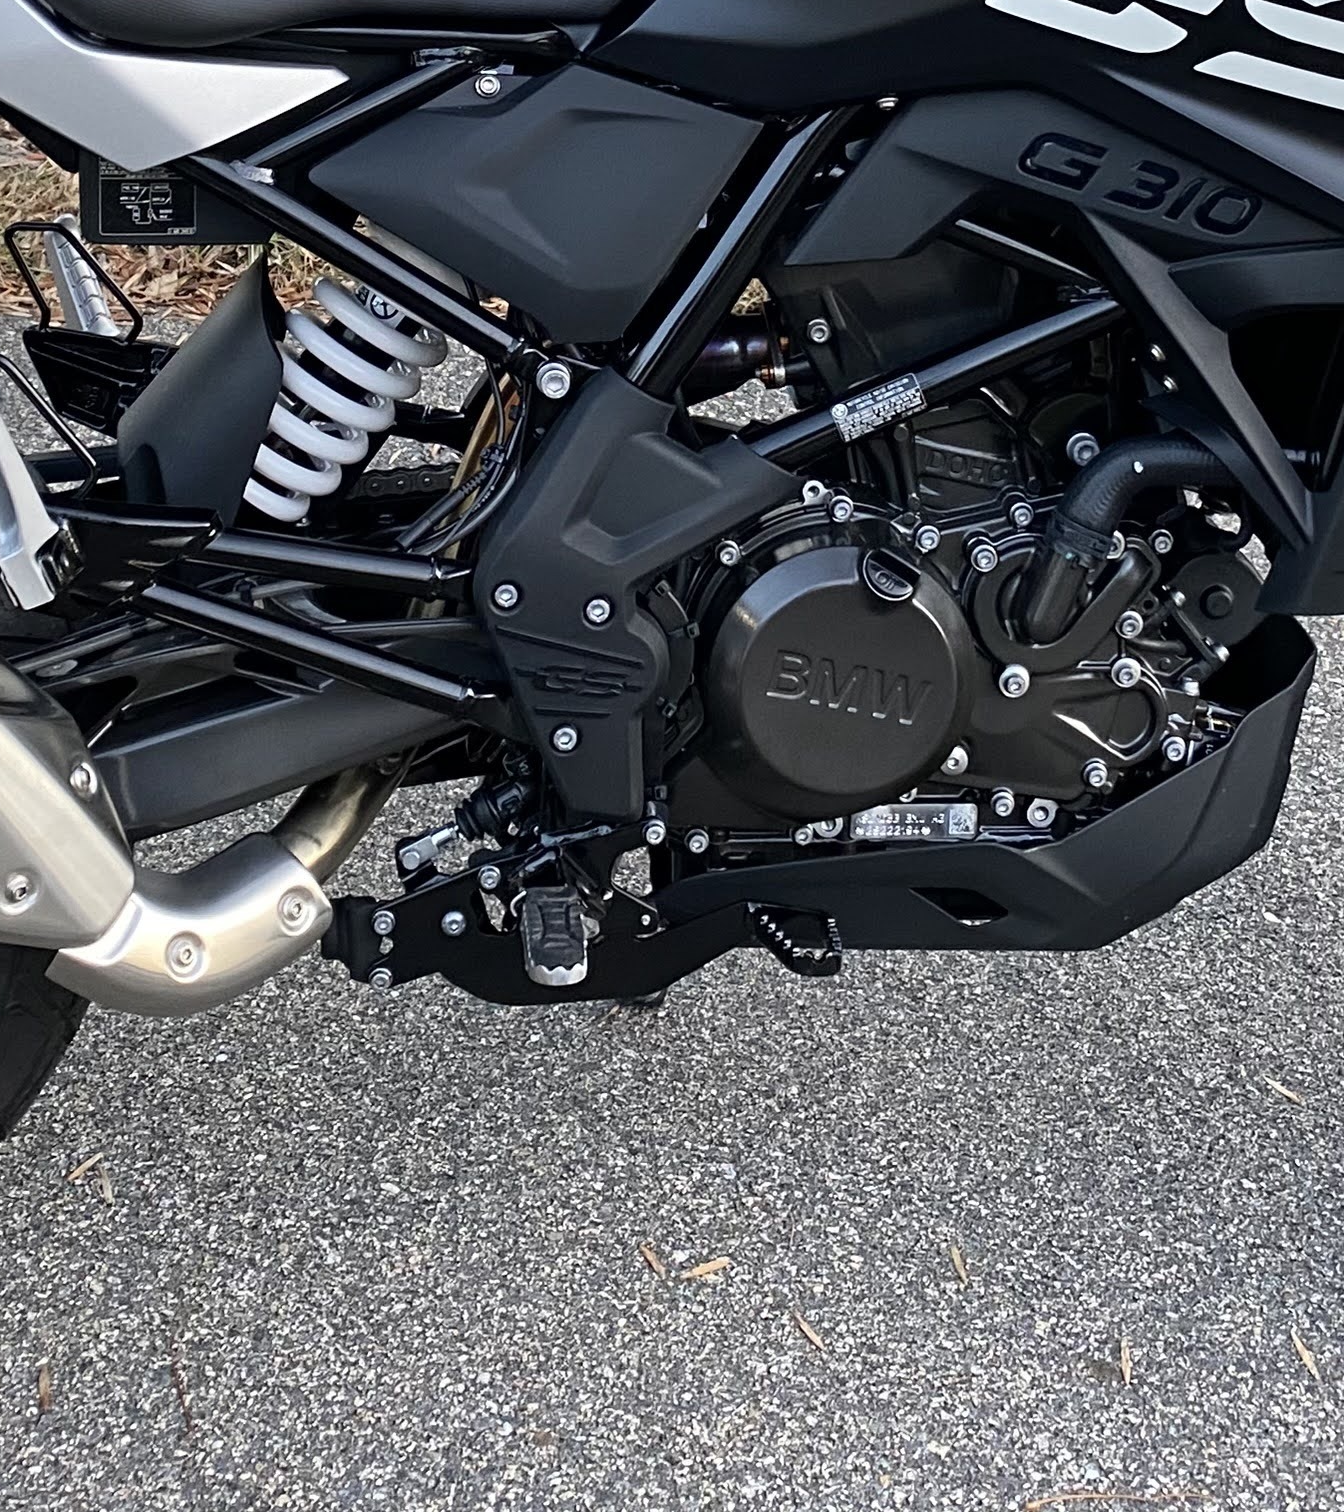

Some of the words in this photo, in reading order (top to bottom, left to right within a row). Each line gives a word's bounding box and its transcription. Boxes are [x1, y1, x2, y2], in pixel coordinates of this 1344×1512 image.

[1017, 132, 1109, 190] G
[1103, 160, 1262, 236] 310
[925, 449, 1008, 485] DOHC
[765, 649, 932, 726] BMW
